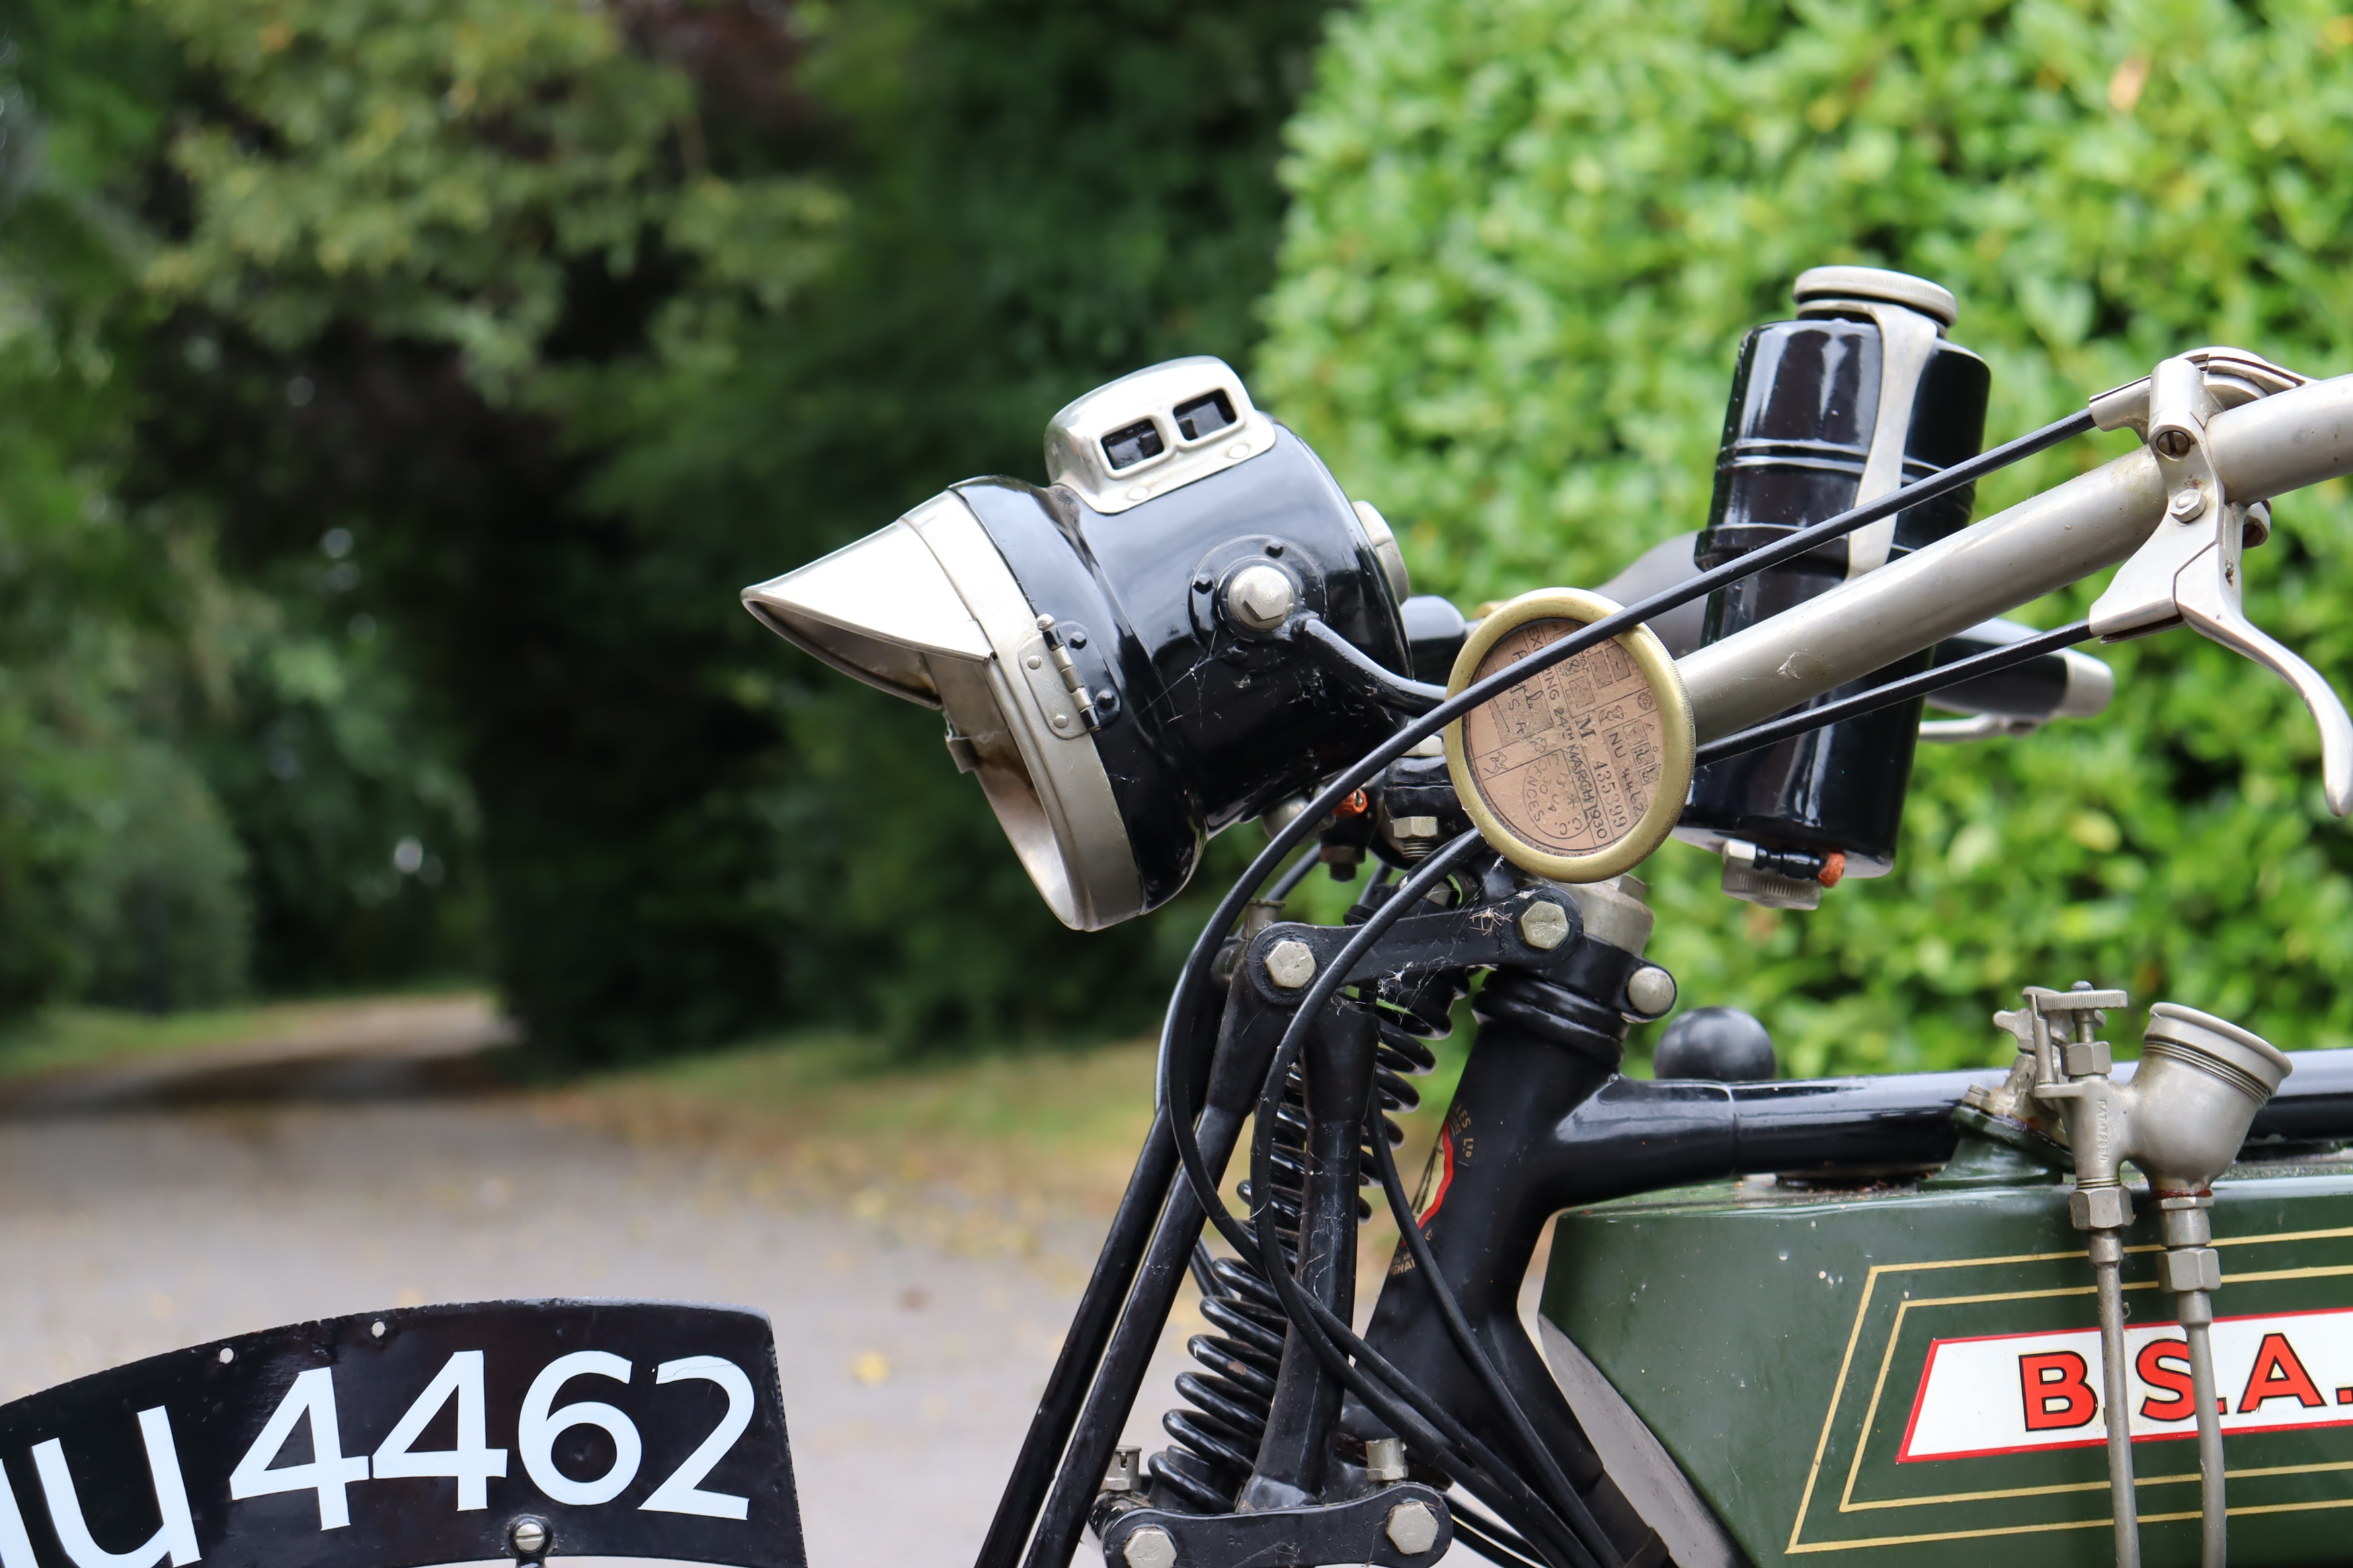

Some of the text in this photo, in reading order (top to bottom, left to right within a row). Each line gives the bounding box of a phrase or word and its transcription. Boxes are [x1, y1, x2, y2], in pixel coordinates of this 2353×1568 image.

[1567, 744, 1595, 802] MARCH
[1587, 804, 1607, 839] 1930
[1575, 714, 1628, 828] M 435399
[1608, 732, 1627, 758] NU
[2018, 1332, 2353, 1432] BS.A.
[229, 1349, 755, 1532] 4462
